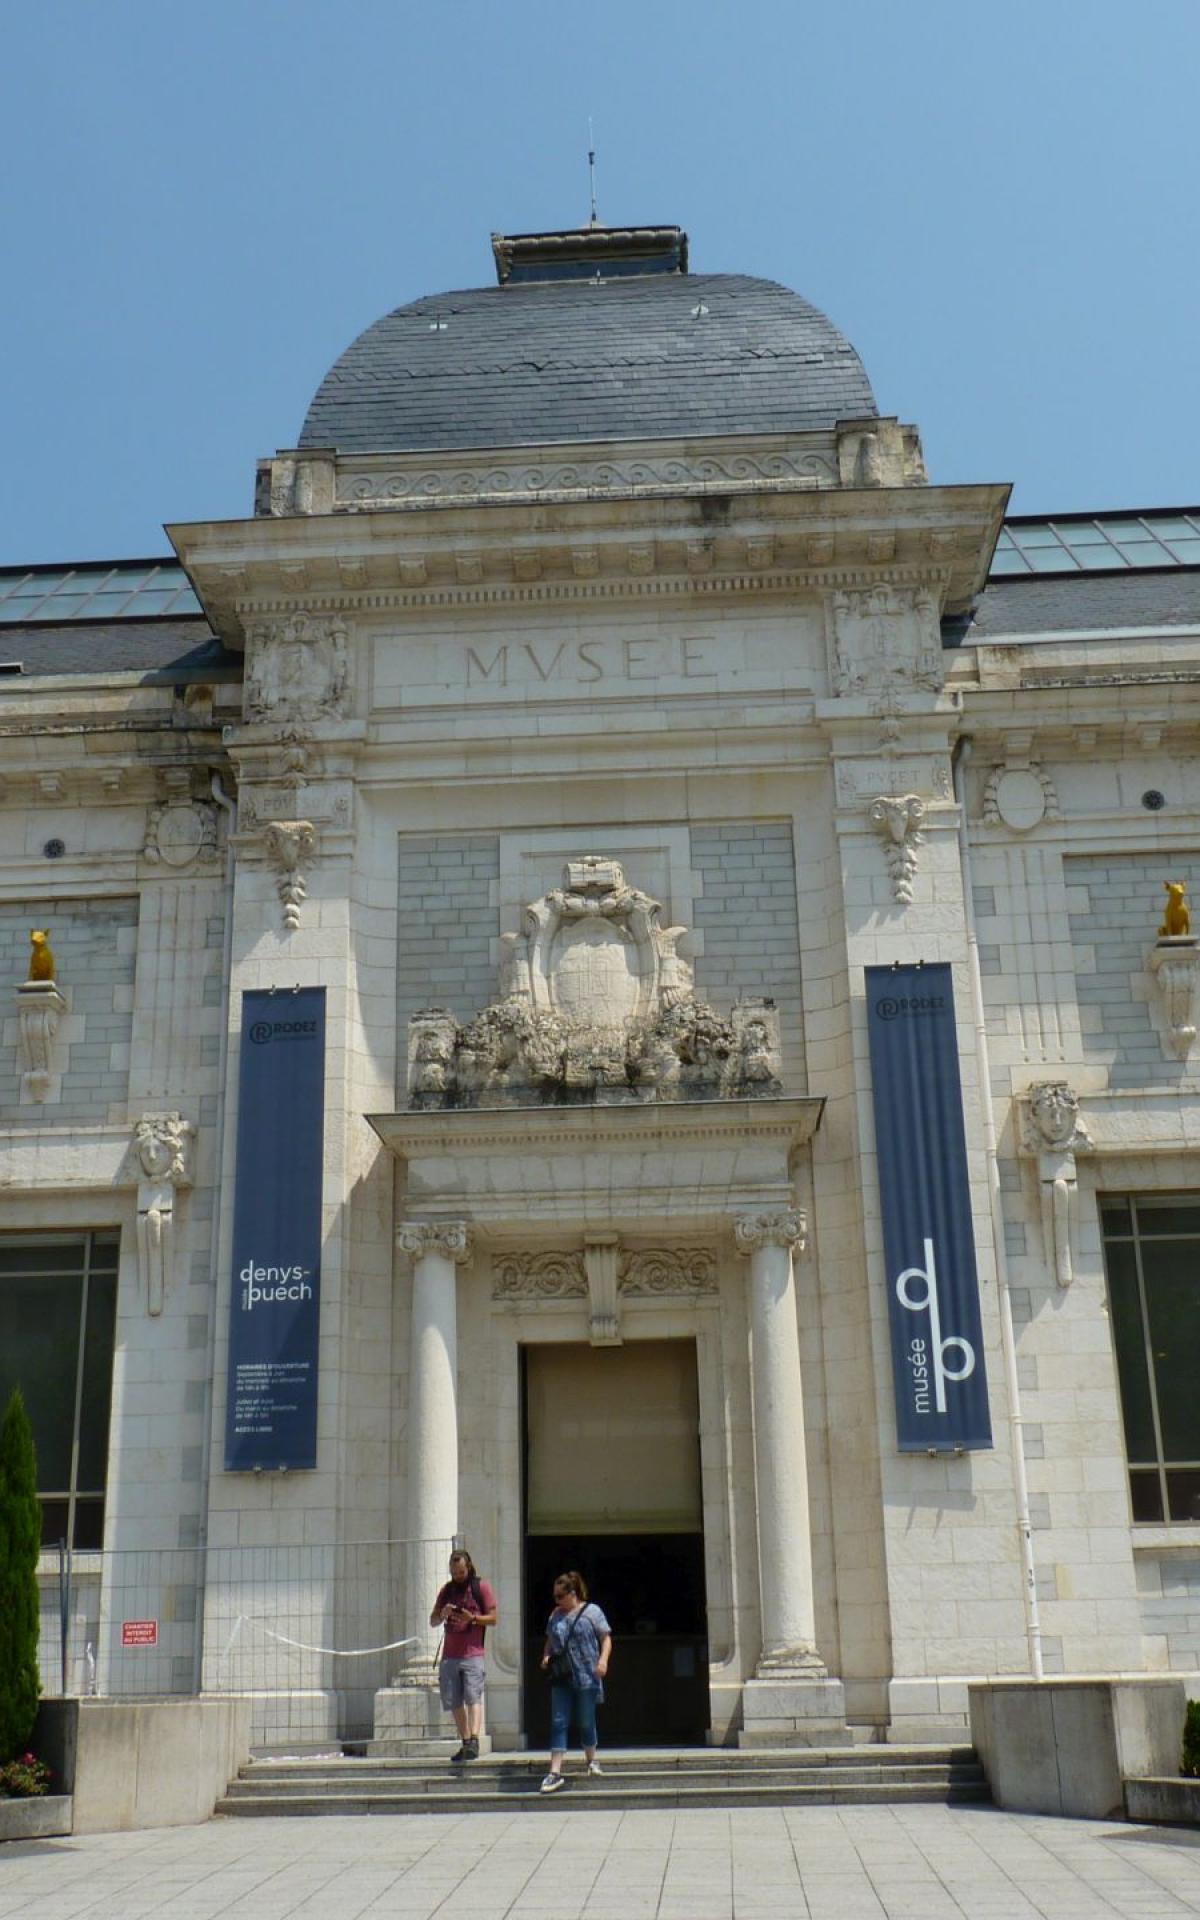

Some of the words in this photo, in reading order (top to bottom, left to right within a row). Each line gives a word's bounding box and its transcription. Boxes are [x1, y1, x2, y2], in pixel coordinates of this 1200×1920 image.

[464, 636, 718, 688] MVSEE
[247, 1281, 312, 1311] puech
[908, 1337, 930, 1413] musée
